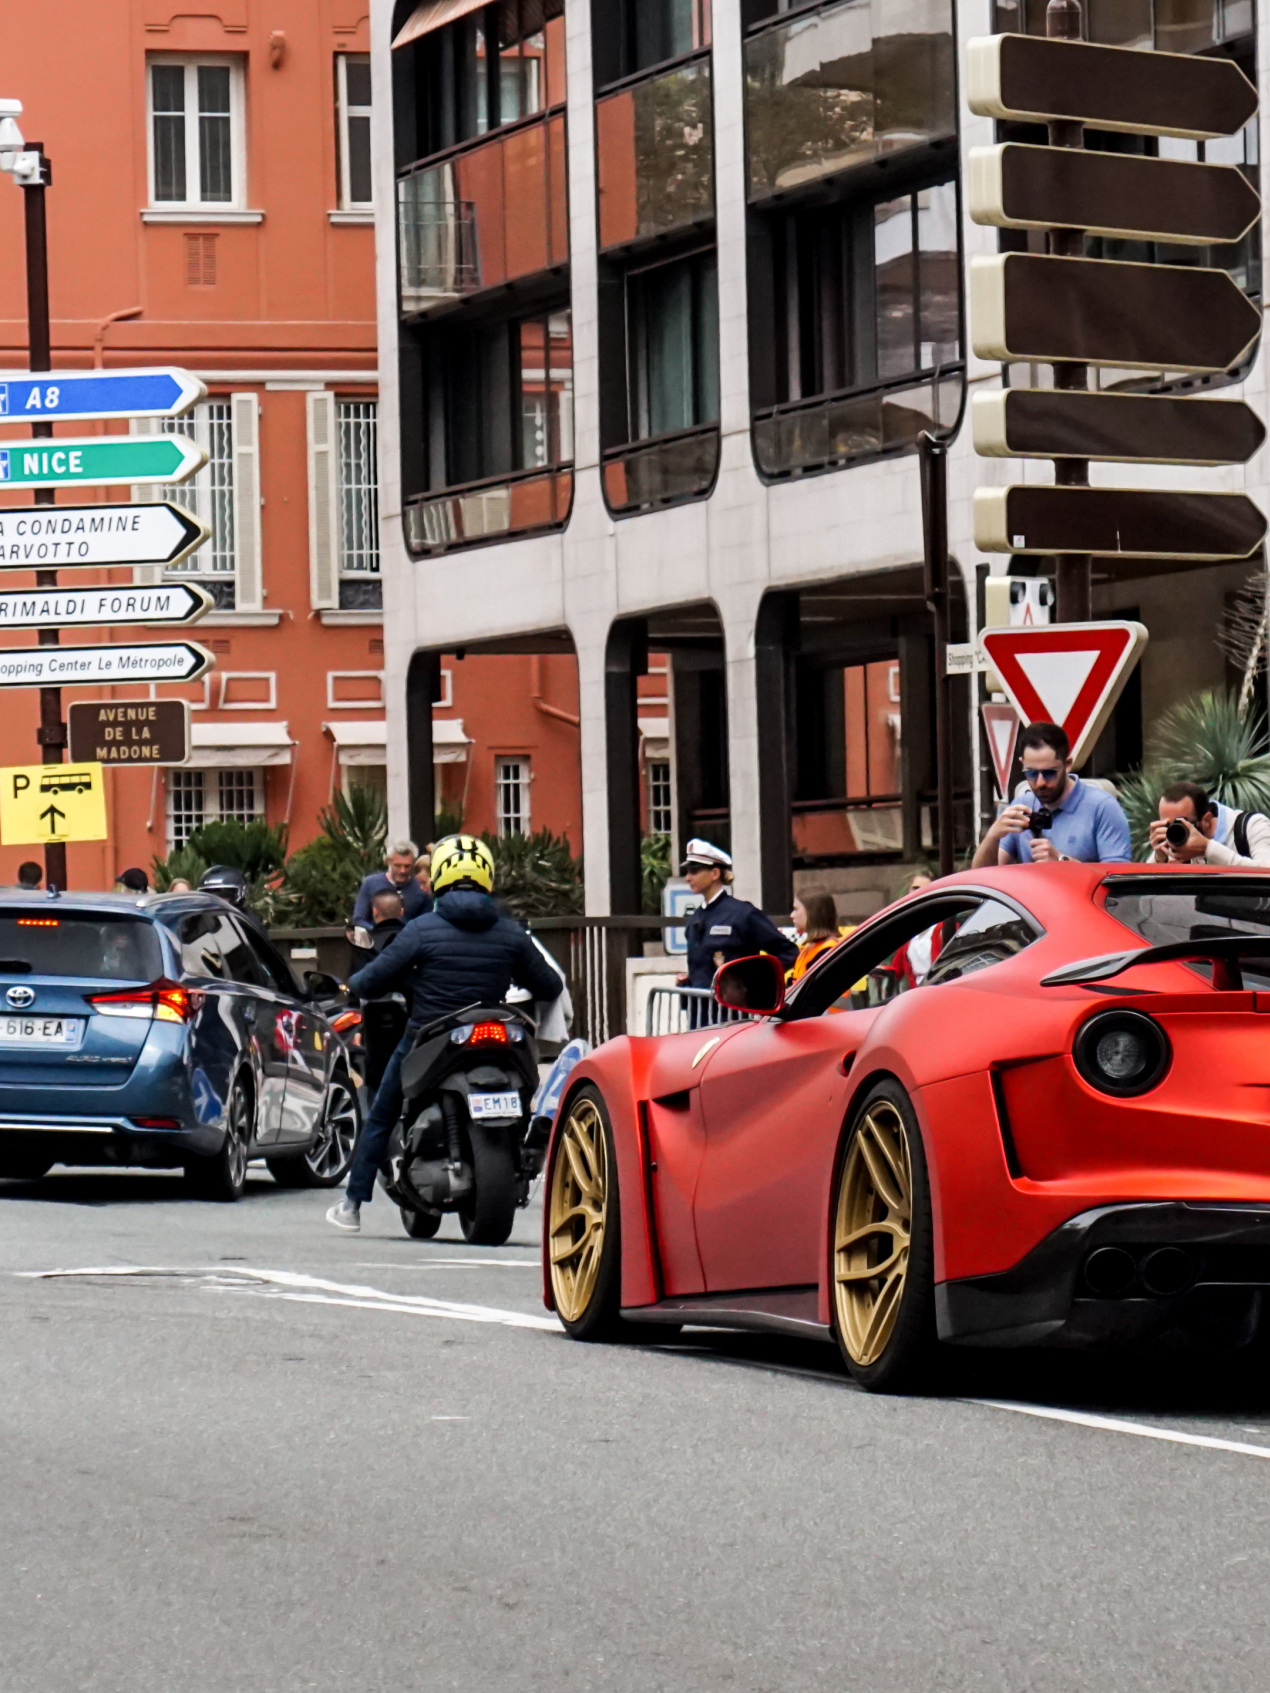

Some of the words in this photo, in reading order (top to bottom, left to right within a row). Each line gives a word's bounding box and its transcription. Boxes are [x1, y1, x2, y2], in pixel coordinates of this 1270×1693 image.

[25, 386, 60, 410] A8
[23, 450, 84, 476] NICE
[16, 514, 142, 536] CONDAMINE
[0, 599, 85, 617] RIMALDI
[98, 595, 171, 614] FORUM
[0, 660, 44, 677] opping
[48, 658, 92, 672] Center
[98, 657, 112, 670] Le
[117, 654, 184, 671] Métropole
[98, 707, 157, 722] AVENUE
[104, 727, 124, 741] DE
[131, 726, 151, 740] LA
[96, 745, 161, 760] MADONE
[13, 774, 30, 799] P
